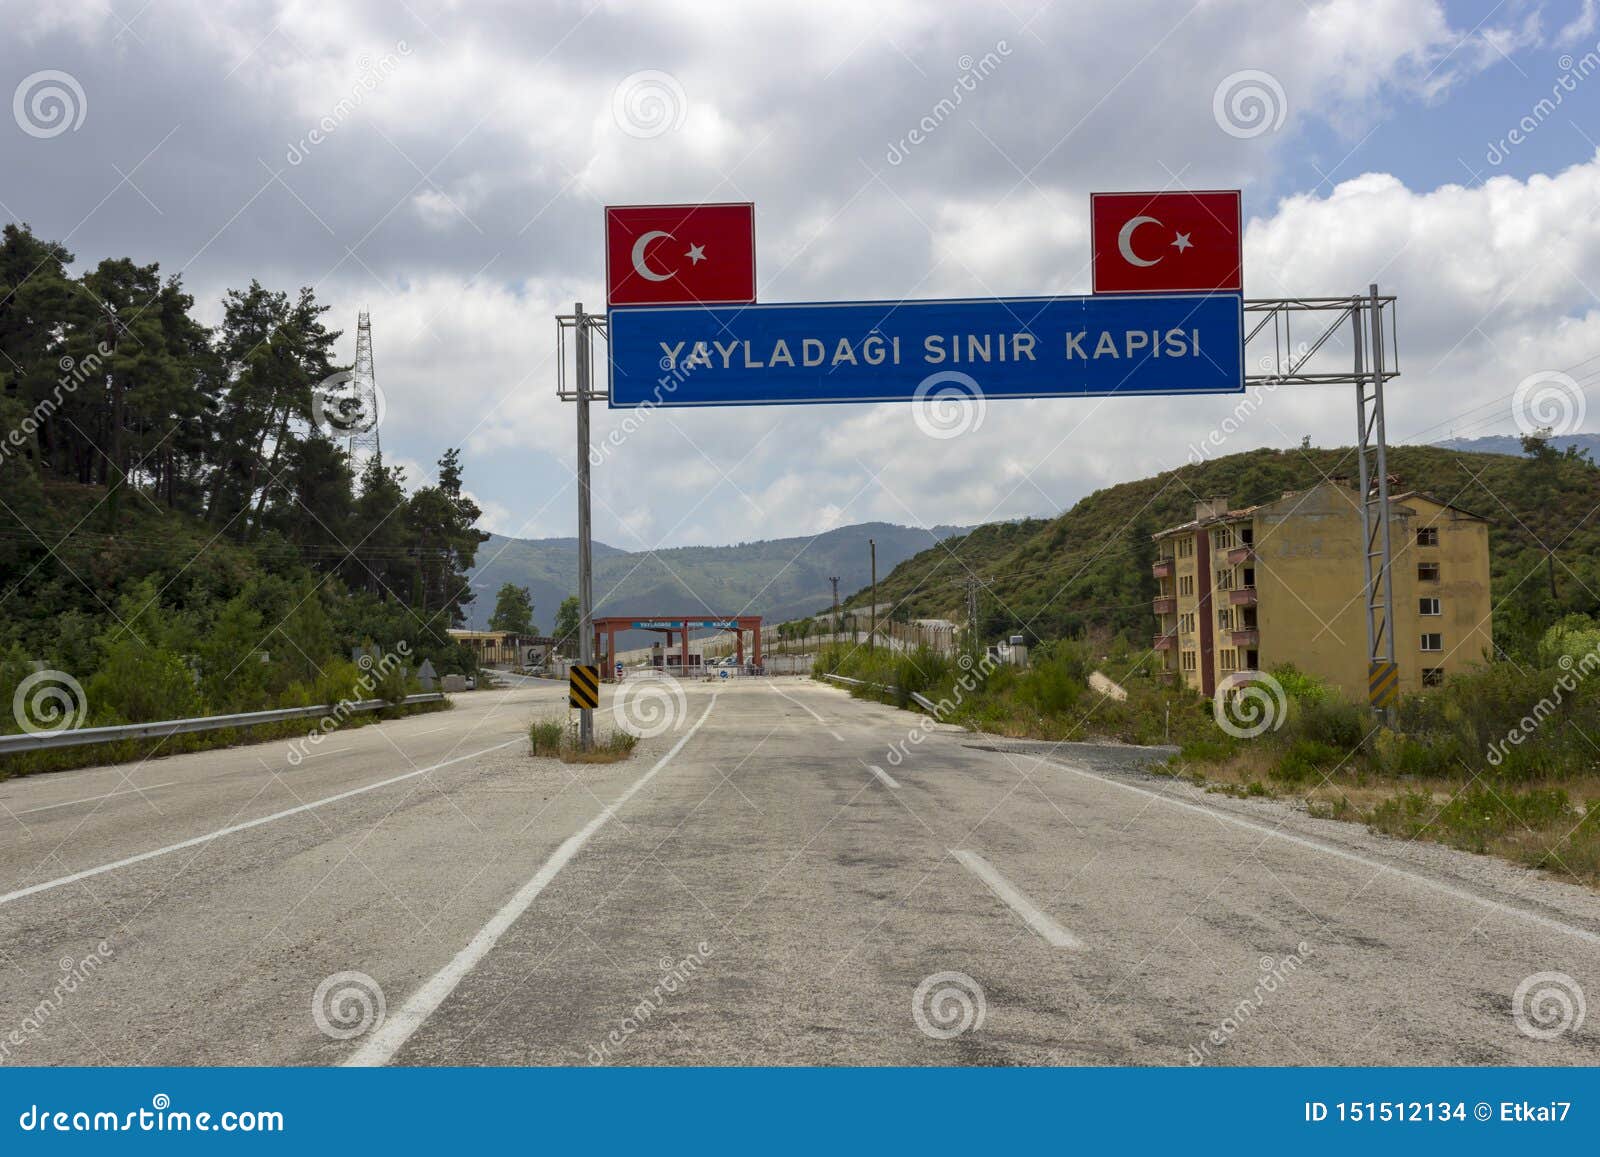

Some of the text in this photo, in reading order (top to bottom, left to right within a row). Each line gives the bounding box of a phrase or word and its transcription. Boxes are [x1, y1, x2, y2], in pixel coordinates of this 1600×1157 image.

[659, 328, 1201, 369] YAYLADAĞI SINIR KAPISI
